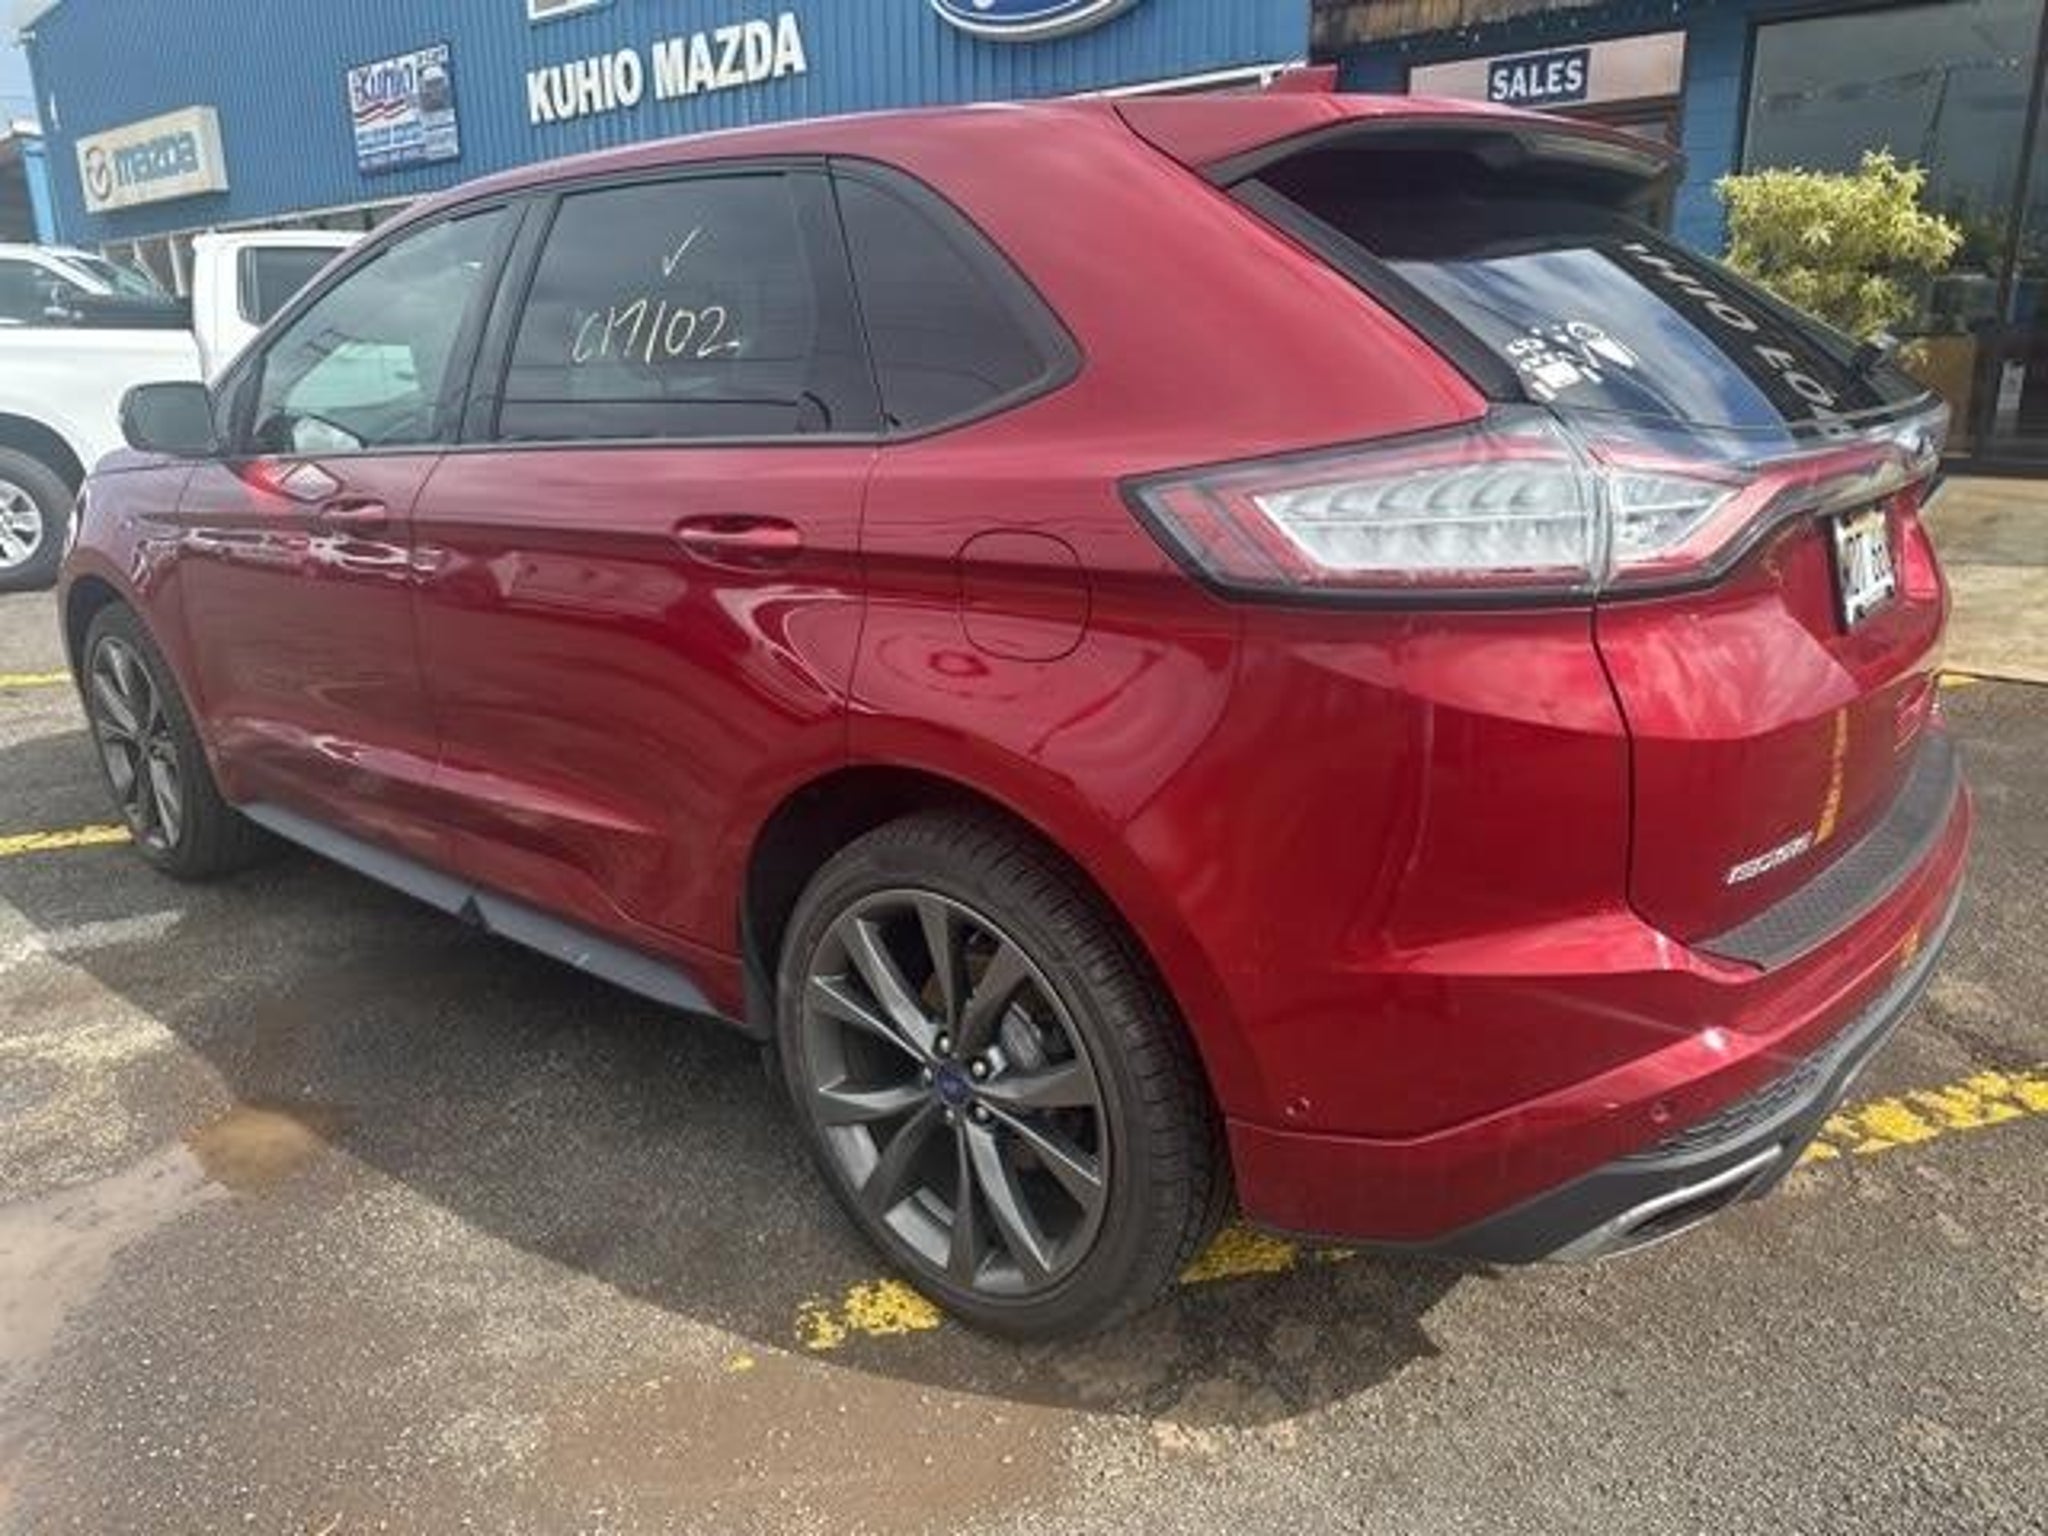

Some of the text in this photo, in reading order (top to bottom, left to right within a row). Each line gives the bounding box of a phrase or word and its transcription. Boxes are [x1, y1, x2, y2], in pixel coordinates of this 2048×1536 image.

[527, 11, 807, 124] KUHIO MAZDA
[1493, 59, 1582, 100] SALES
[113, 131, 200, 186] mazda
